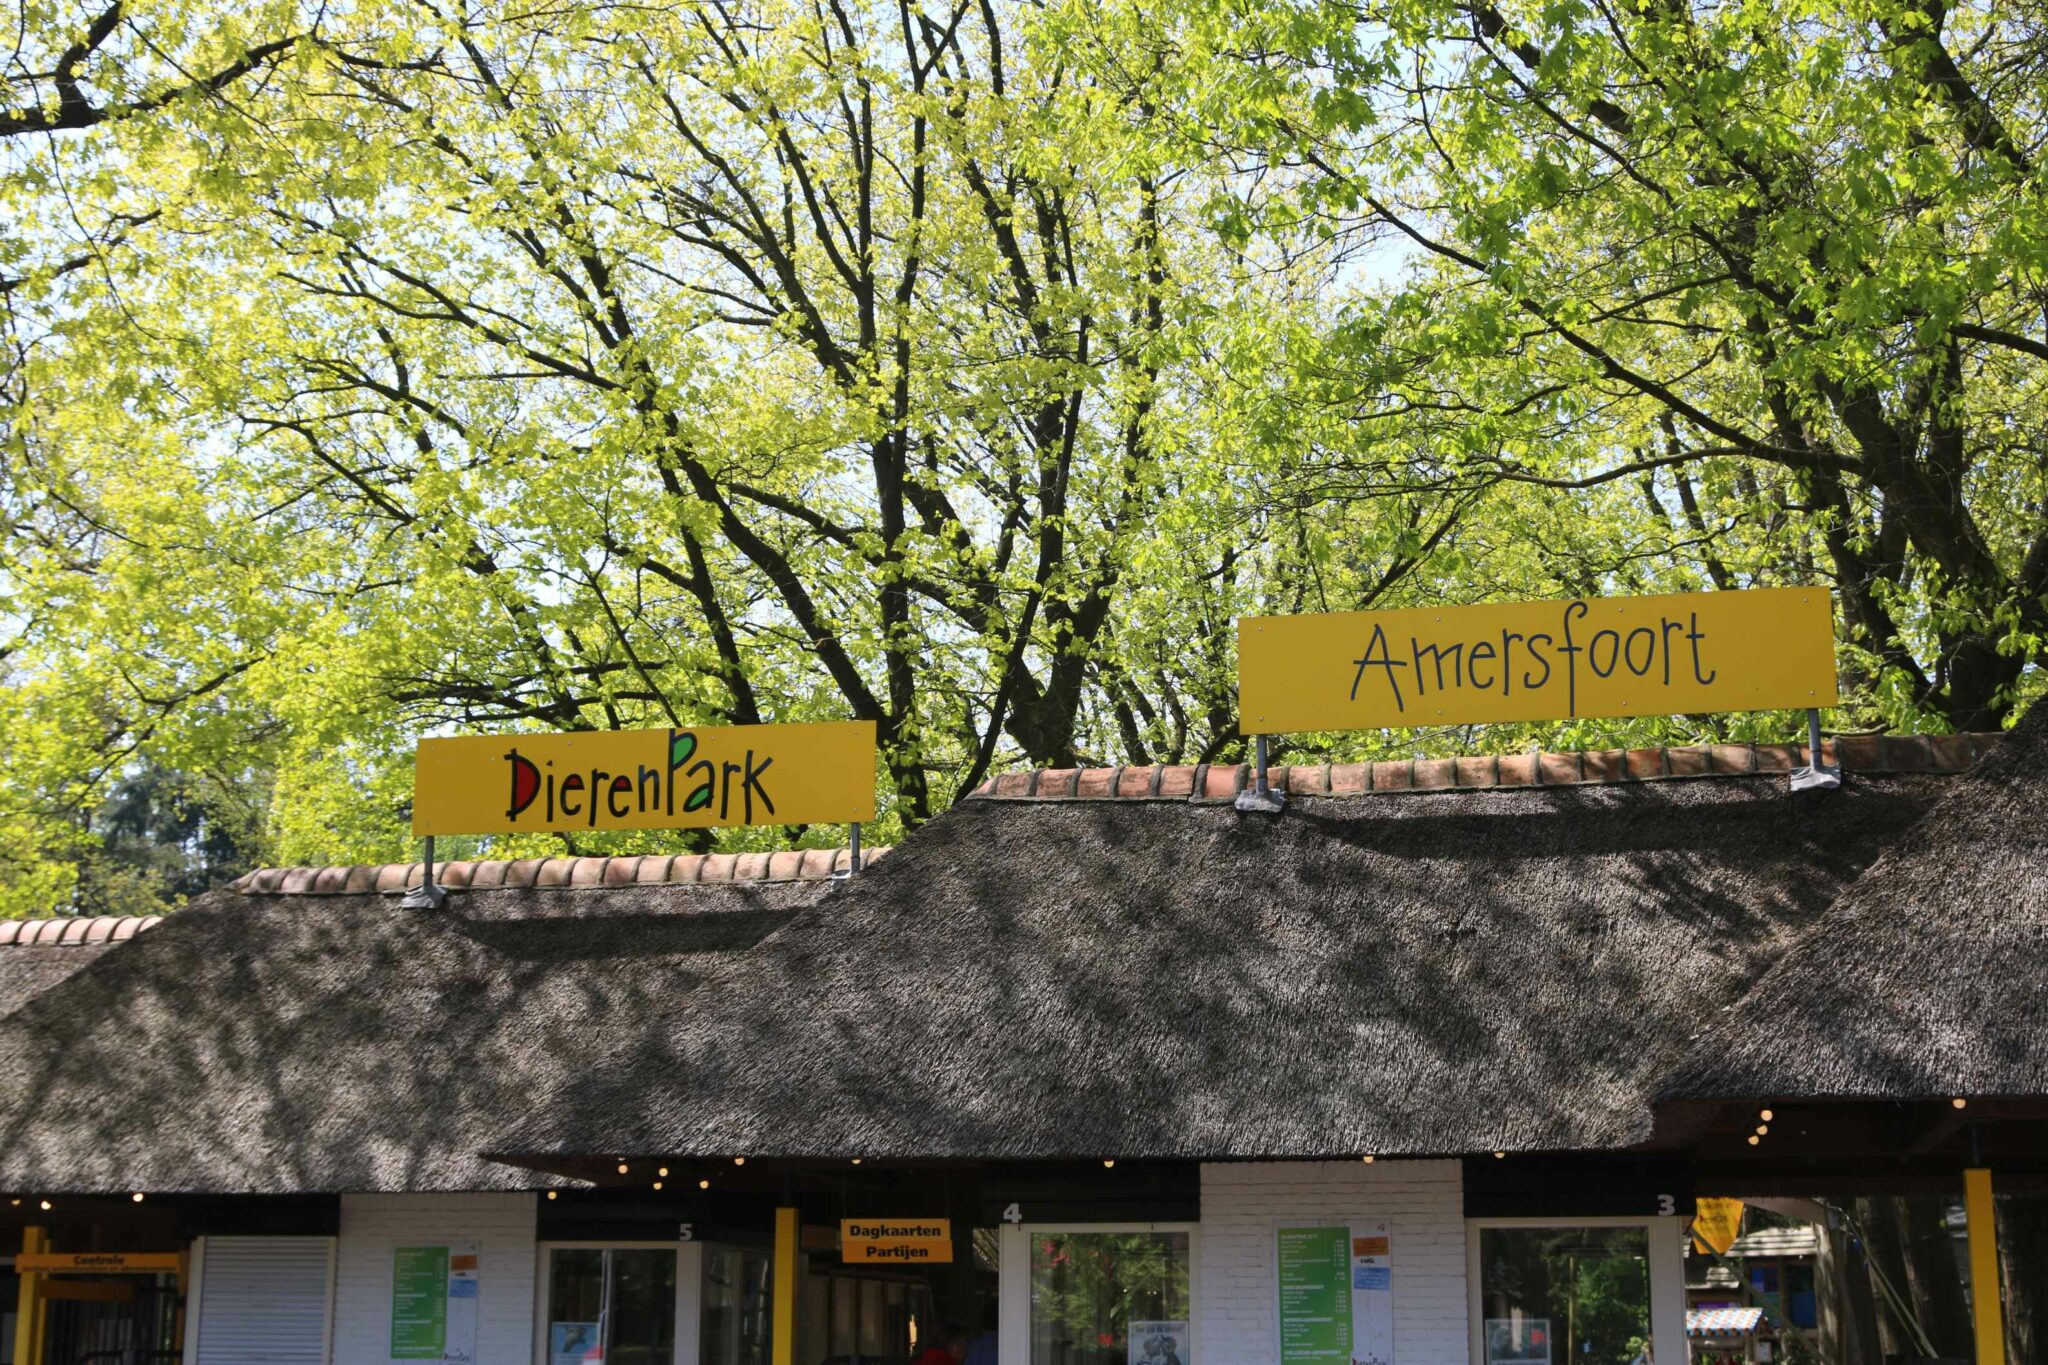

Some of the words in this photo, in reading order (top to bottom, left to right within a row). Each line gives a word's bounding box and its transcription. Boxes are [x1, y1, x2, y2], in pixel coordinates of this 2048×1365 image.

[1351, 601, 1716, 717] Amersfoort
[504, 728, 775, 827] DierenPark
[1003, 1203, 1022, 1223] 4
[1657, 1194, 1676, 1216] 3
[679, 1223, 693, 1241] 5
[850, 1225, 941, 1239] Dagkaarten
[866, 1246, 928, 1260] Partijen
